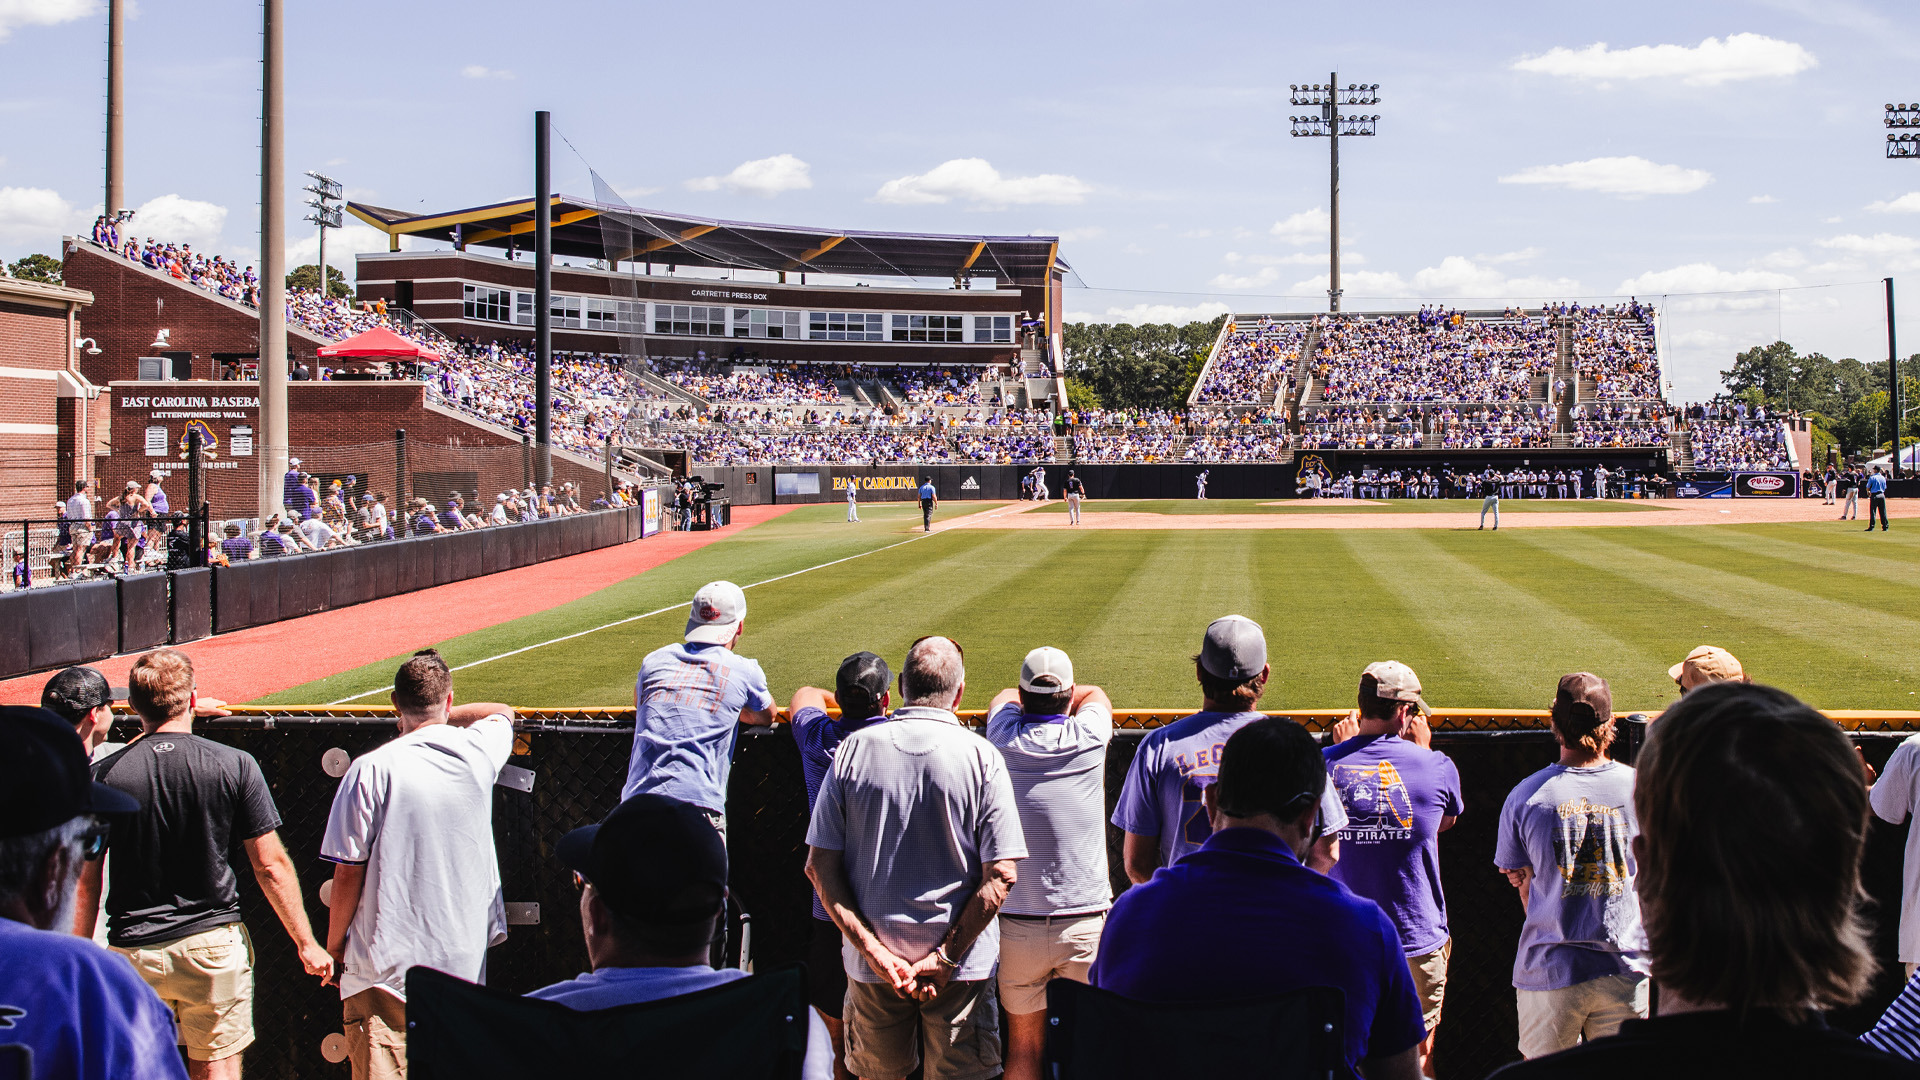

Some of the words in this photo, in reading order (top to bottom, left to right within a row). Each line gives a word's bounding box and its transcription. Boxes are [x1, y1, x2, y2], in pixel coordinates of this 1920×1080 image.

[691, 290, 731, 298] CARTRETTE
[121, 397, 150, 408] EAST
[152, 396, 208, 408] CAROLINA
[211, 396, 261, 408] BASEBA
[832, 477, 861, 490] EAT
[863, 476, 918, 491] CAROLINA
[1557, 797, 1621, 819] Welcome
[1336, 831, 1352, 841] CU
[1357, 830, 1412, 841] PIRATES
